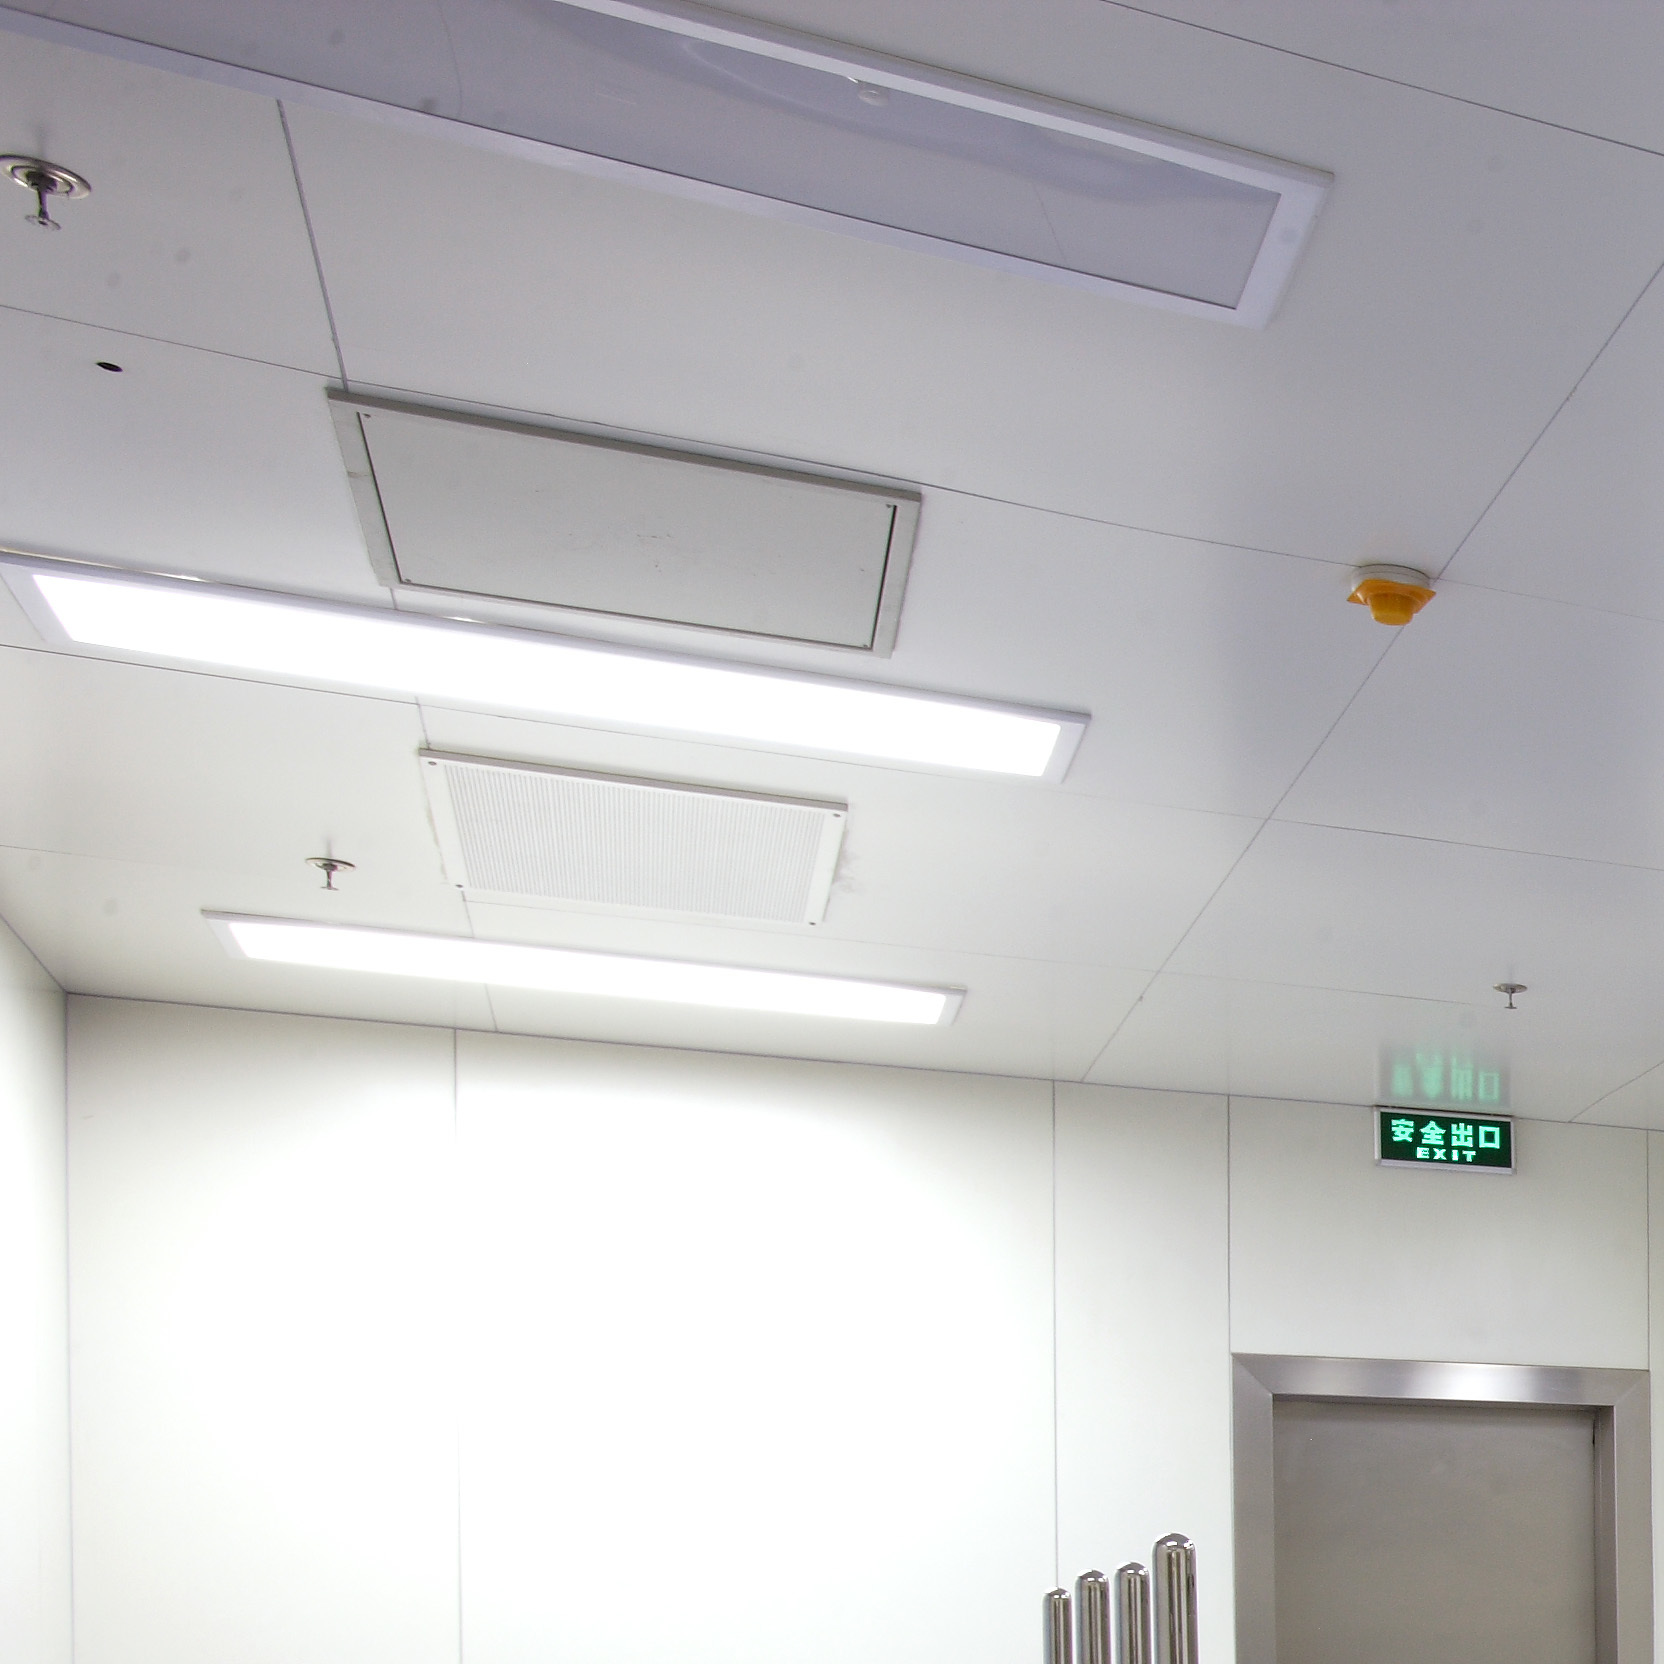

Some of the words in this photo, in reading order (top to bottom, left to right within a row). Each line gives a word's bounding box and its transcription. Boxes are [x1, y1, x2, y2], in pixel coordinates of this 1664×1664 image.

[1391, 1119, 1500, 1149] 安全出口
[1417, 1147, 1476, 1162] EXIT
